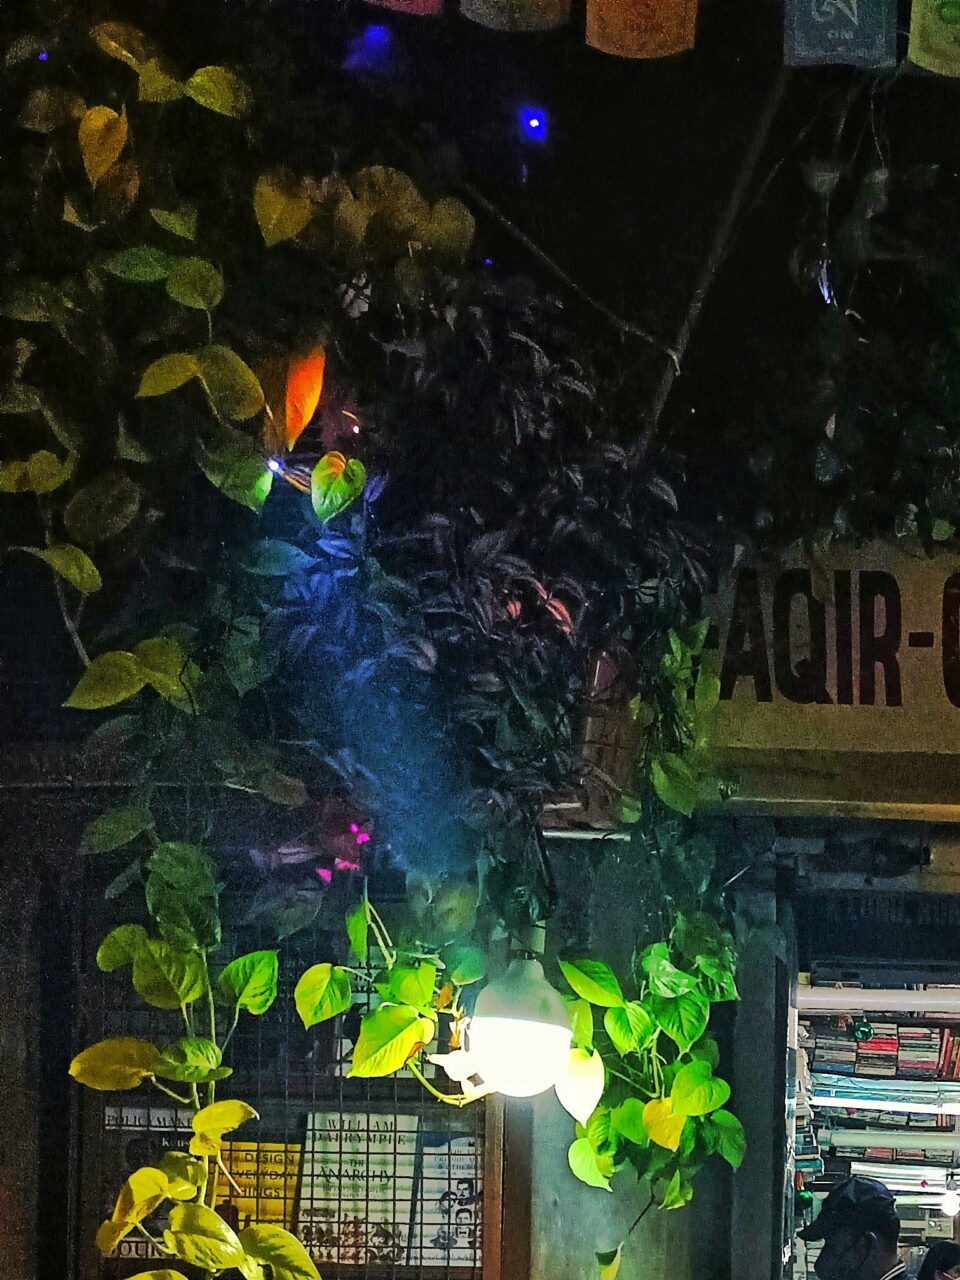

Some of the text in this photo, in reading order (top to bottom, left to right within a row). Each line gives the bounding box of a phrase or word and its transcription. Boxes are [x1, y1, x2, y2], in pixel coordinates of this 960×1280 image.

[327, 1119, 395, 1131] WILLAM
[236, 1170, 296, 1180] VEYDAY
[316, 1165, 393, 1183] ANARCHY
[238, 1186, 281, 1198] HINGS
